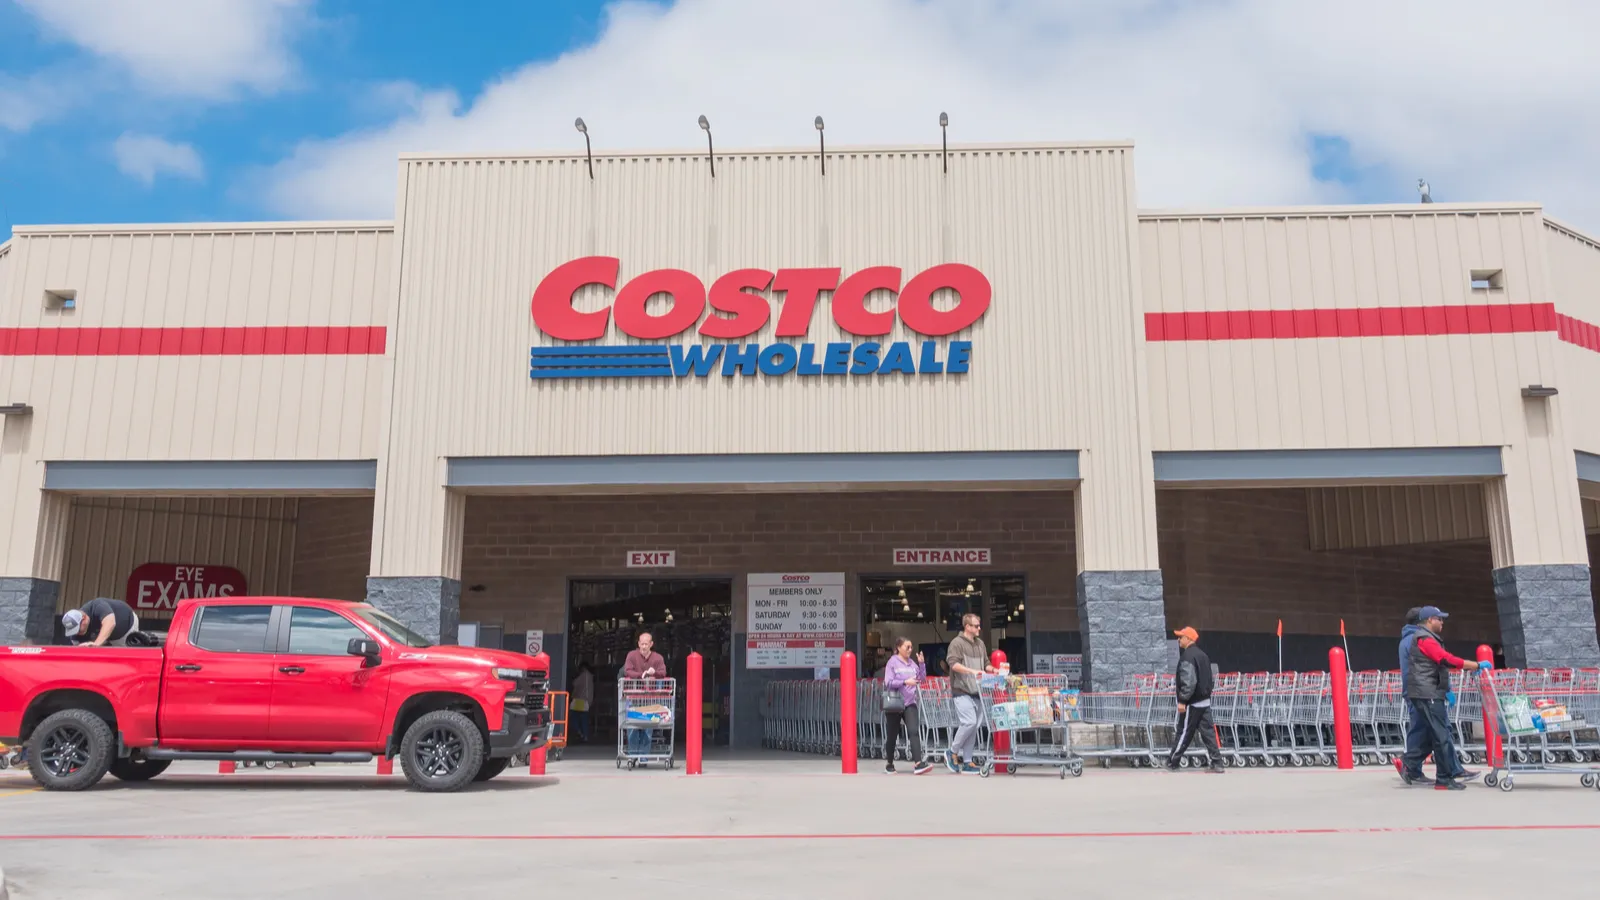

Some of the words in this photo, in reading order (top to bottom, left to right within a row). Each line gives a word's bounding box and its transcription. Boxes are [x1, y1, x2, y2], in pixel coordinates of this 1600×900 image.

[531, 256, 992, 341] COSTCO
[670, 341, 972, 378] WHOLESALE
[631, 552, 670, 565] EXIT
[895, 550, 989, 563] ENTRANCE
[175, 566, 205, 582] EYE
[769, 588, 803, 596] MEMBERS
[804, 588, 823, 596] ONLY
[755, 600, 771, 608] MON
[776, 599, 788, 608] FRI
[799, 599, 818, 607] 10:00
[822, 598, 838, 607] 8:30
[755, 611, 791, 619] SATURDAY
[802, 610, 818, 619] 9:30
[822, 610, 838, 619] 6:00
[755, 622, 783, 631] SUNDAY
[799, 622, 818, 631] 10:00
[822, 622, 838, 630] 6:00
